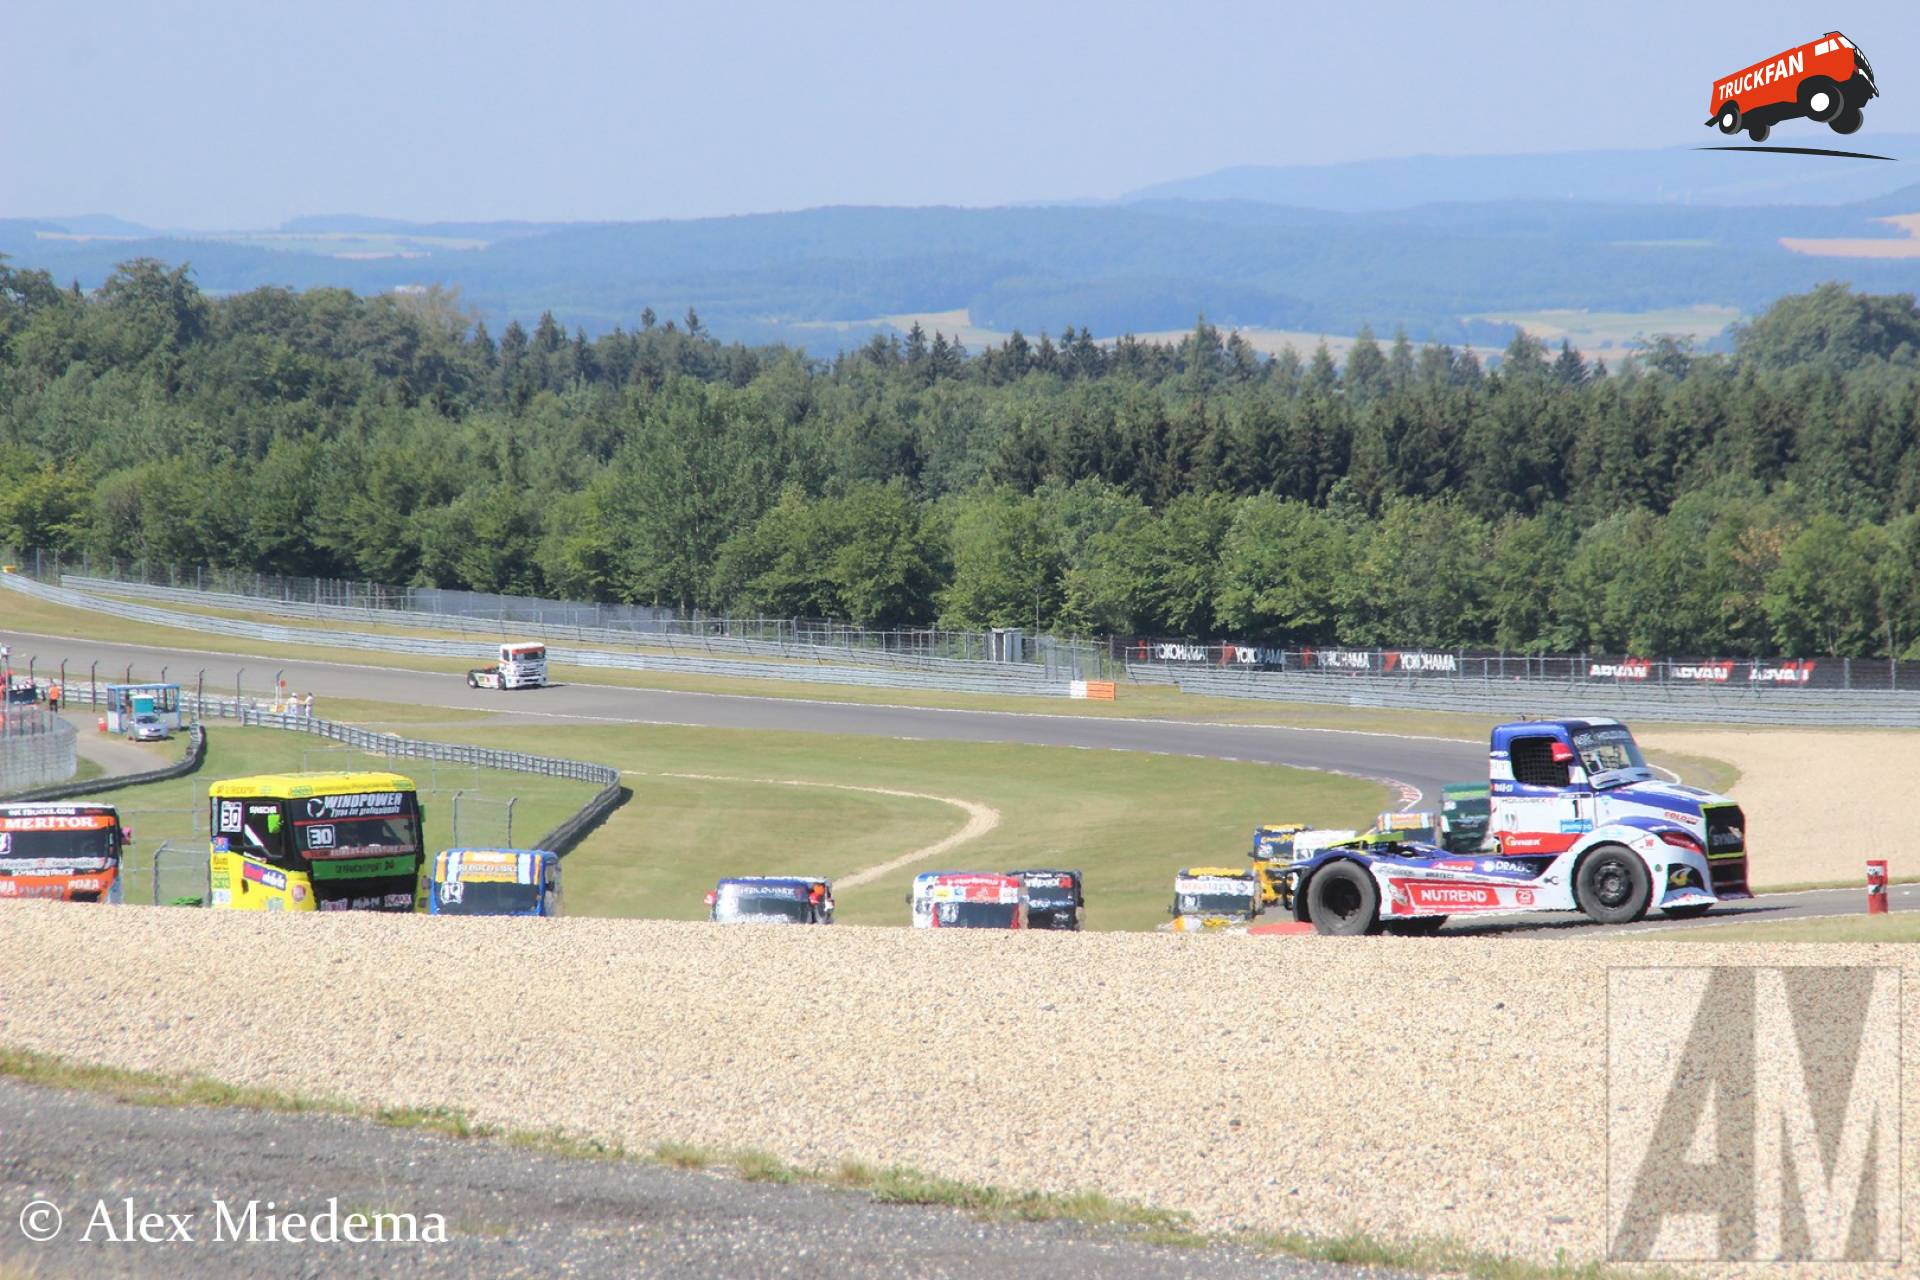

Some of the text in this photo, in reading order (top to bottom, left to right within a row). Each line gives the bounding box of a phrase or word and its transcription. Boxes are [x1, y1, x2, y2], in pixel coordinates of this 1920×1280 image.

[1154, 643, 1207, 661] YOKOHAMA
[1400, 653, 1456, 671] YOKOHAMA
[1590, 664, 1647, 678] ADVAN
[1671, 666, 1728, 679] ADVAN
[324, 793, 403, 809] WINDPOWER
[1572, 800, 1580, 818] 1
[223, 809, 240, 827] 30
[309, 828, 333, 845] 30
[1421, 890, 1487, 902] NUTREND
